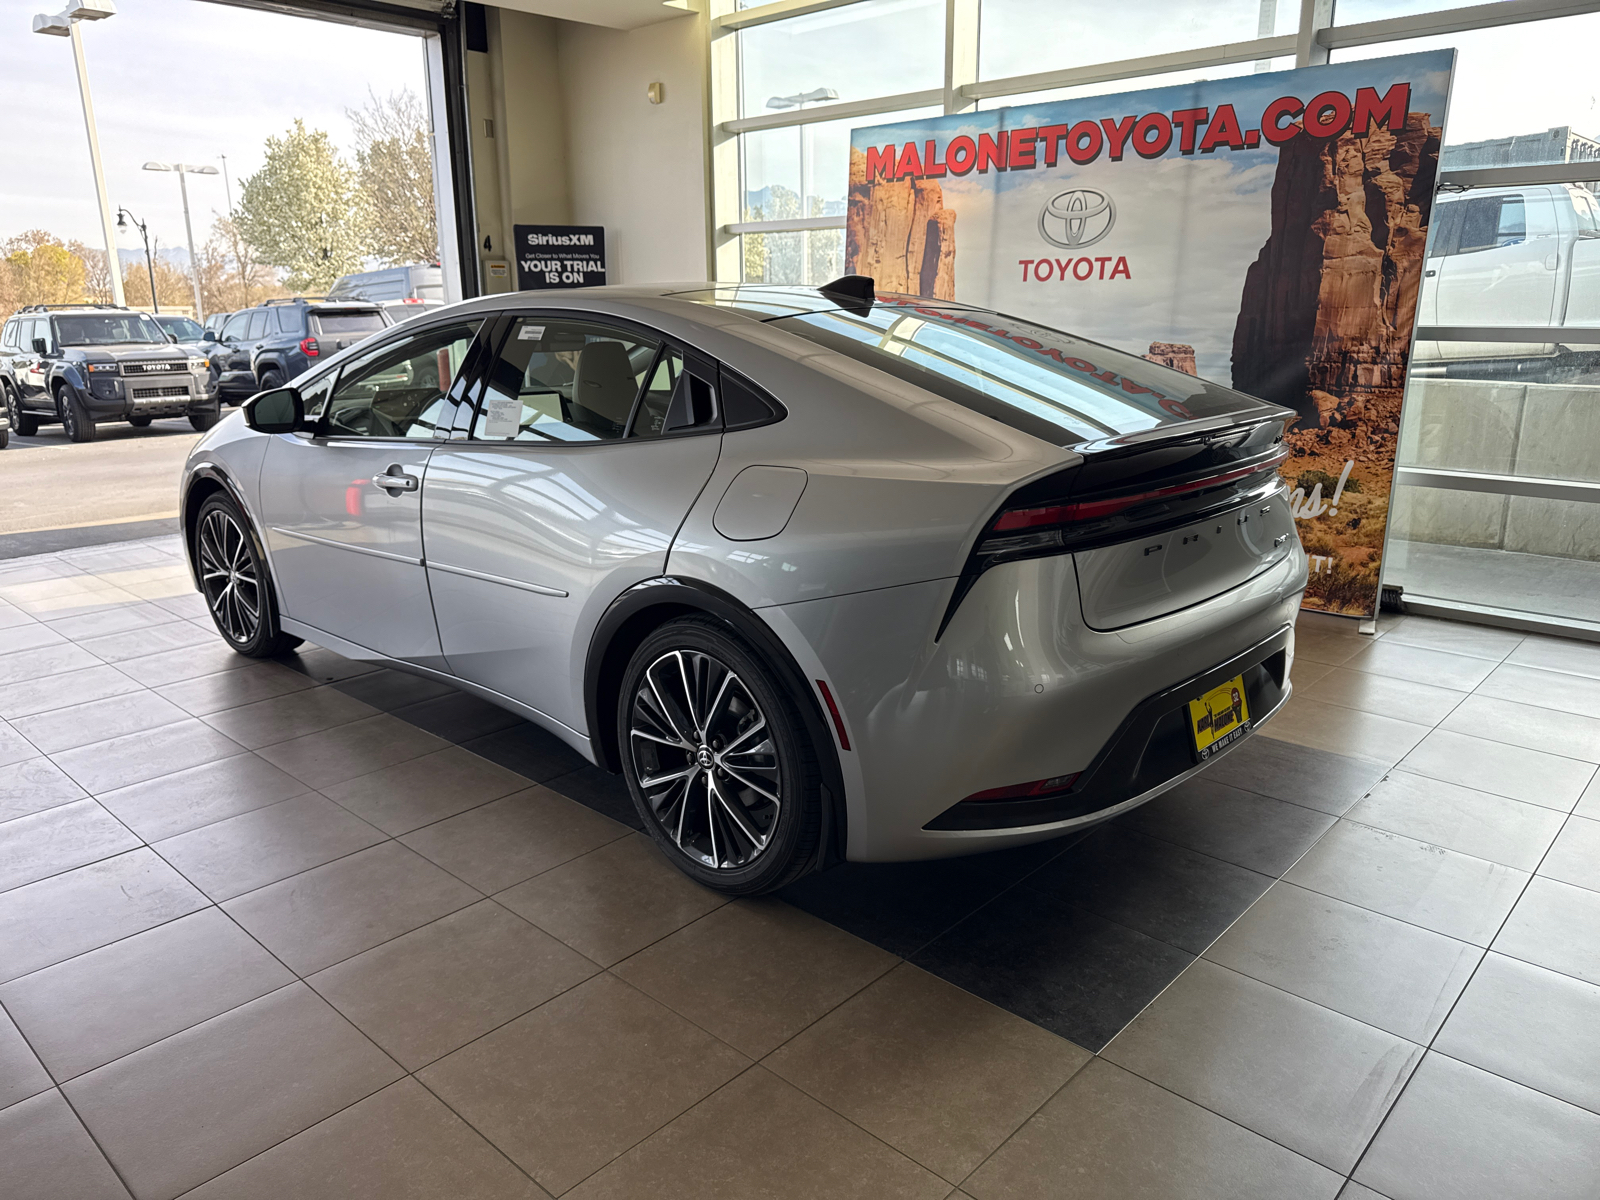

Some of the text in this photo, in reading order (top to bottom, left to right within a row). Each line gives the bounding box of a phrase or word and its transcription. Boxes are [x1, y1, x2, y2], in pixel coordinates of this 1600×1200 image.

[865, 82, 1411, 184] MALONETOYOTA.COM
[484, 235, 492, 252] 4
[527, 234, 594, 246] SiriusXM
[520, 260, 606, 272] YOUR TRIAL
[1018, 256, 1132, 283] TOYOTA
[545, 272, 584, 284] IS ON
[1144, 505, 1271, 556] PRIUS
[1233, 692, 1239, 702] 32
[1214, 710, 1234, 732] MALONE
[1211, 744, 1218, 753] WE
[1218, 737, 1229, 749] MAKE
[1233, 728, 1242, 739] EASY
